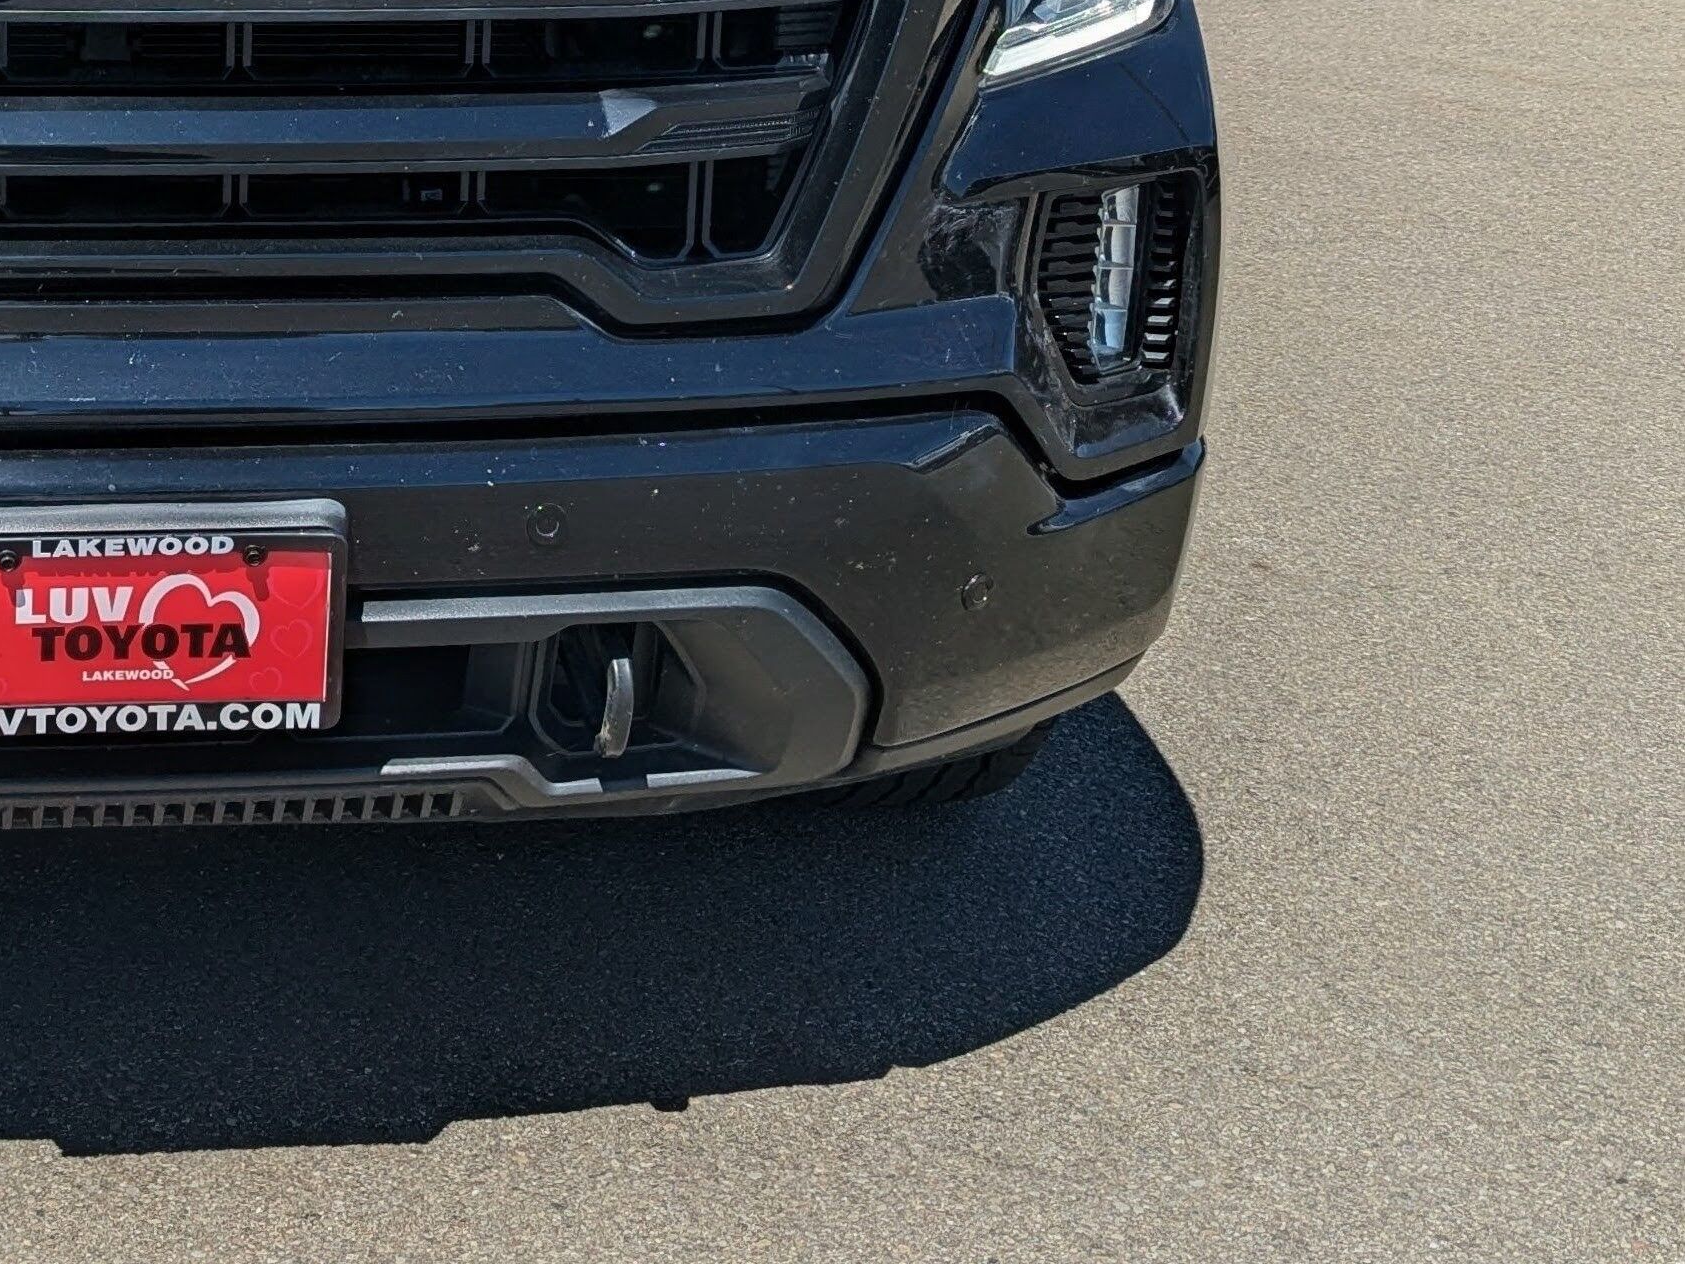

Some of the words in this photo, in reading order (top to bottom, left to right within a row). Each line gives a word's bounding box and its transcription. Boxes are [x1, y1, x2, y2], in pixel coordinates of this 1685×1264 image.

[32, 535, 235, 559] LAKEWOOD
[15, 586, 134, 625] LUV
[31, 622, 251, 662] TOYOTA
[81, 668, 175, 682] LAKEWOOD
